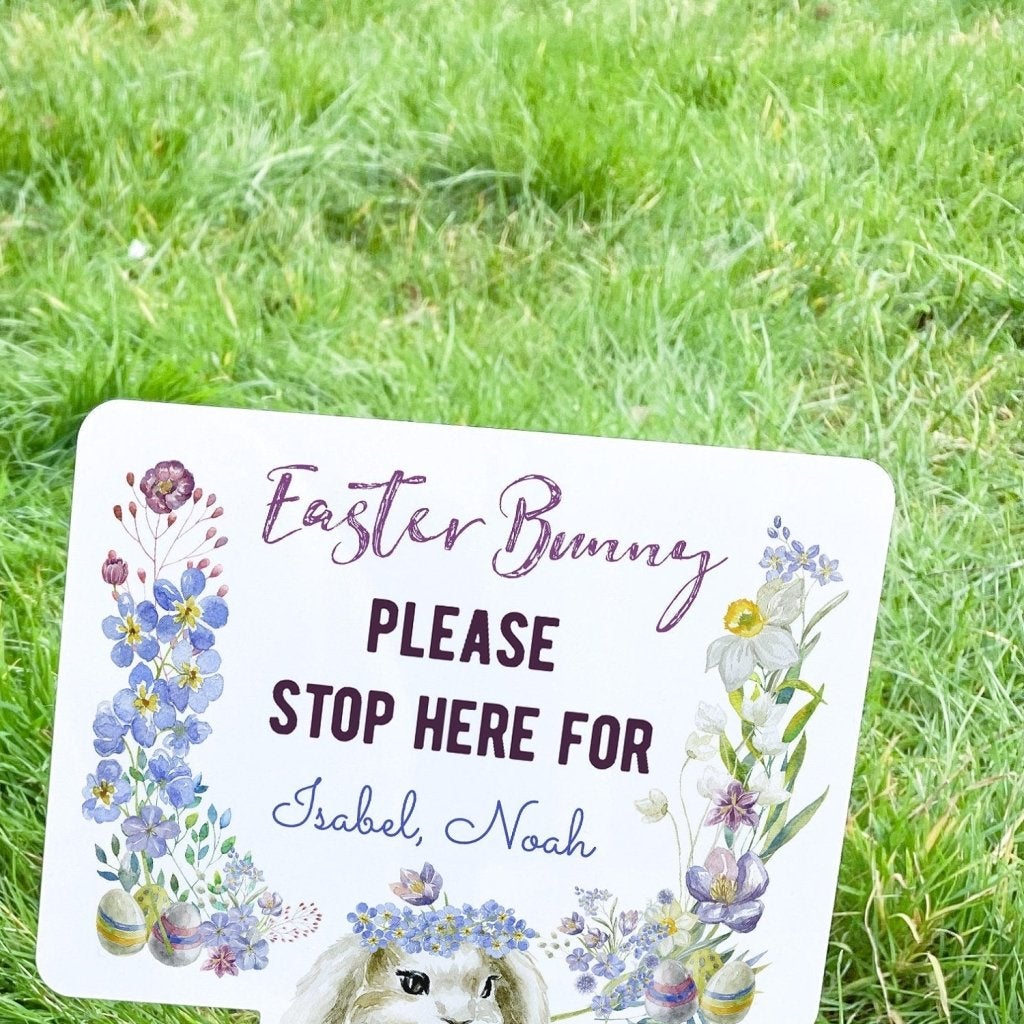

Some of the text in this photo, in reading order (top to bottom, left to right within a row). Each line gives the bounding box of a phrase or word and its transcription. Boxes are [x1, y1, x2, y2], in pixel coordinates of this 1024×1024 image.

[261, 463, 729, 634] Easter Bunny
[366, 597, 561, 673] PLEASE
[268, 678, 654, 775] STOP HERE FOR
[271, 776, 597, 859] Isabel, Noah
